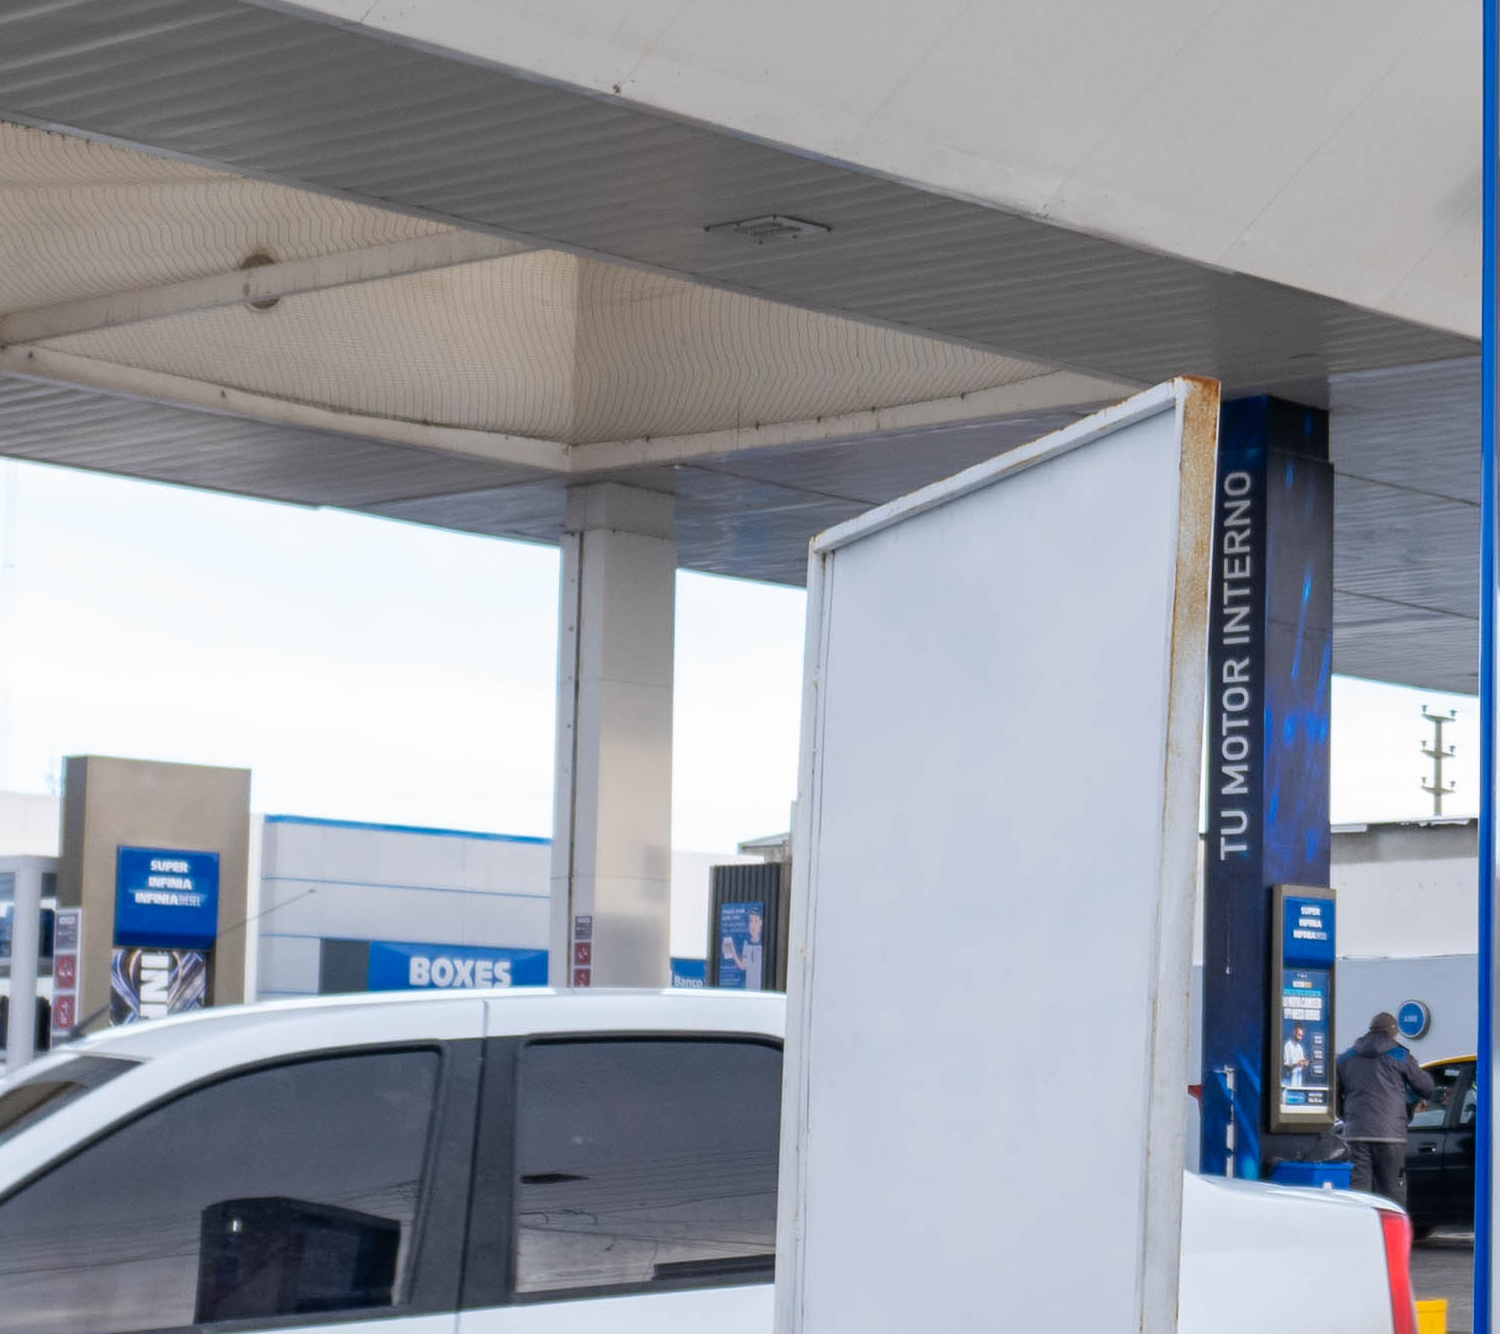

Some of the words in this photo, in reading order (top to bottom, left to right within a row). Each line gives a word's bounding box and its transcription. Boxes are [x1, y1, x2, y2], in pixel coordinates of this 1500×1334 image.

[1222, 470, 1253, 645] INTERNO
[1221, 656, 1250, 795] MOTOR
[1220, 810, 1249, 861] TU
[148, 876, 193, 890] INFINIA
[150, 860, 189, 873] SUPER
[409, 956, 512, 988] BOXES
